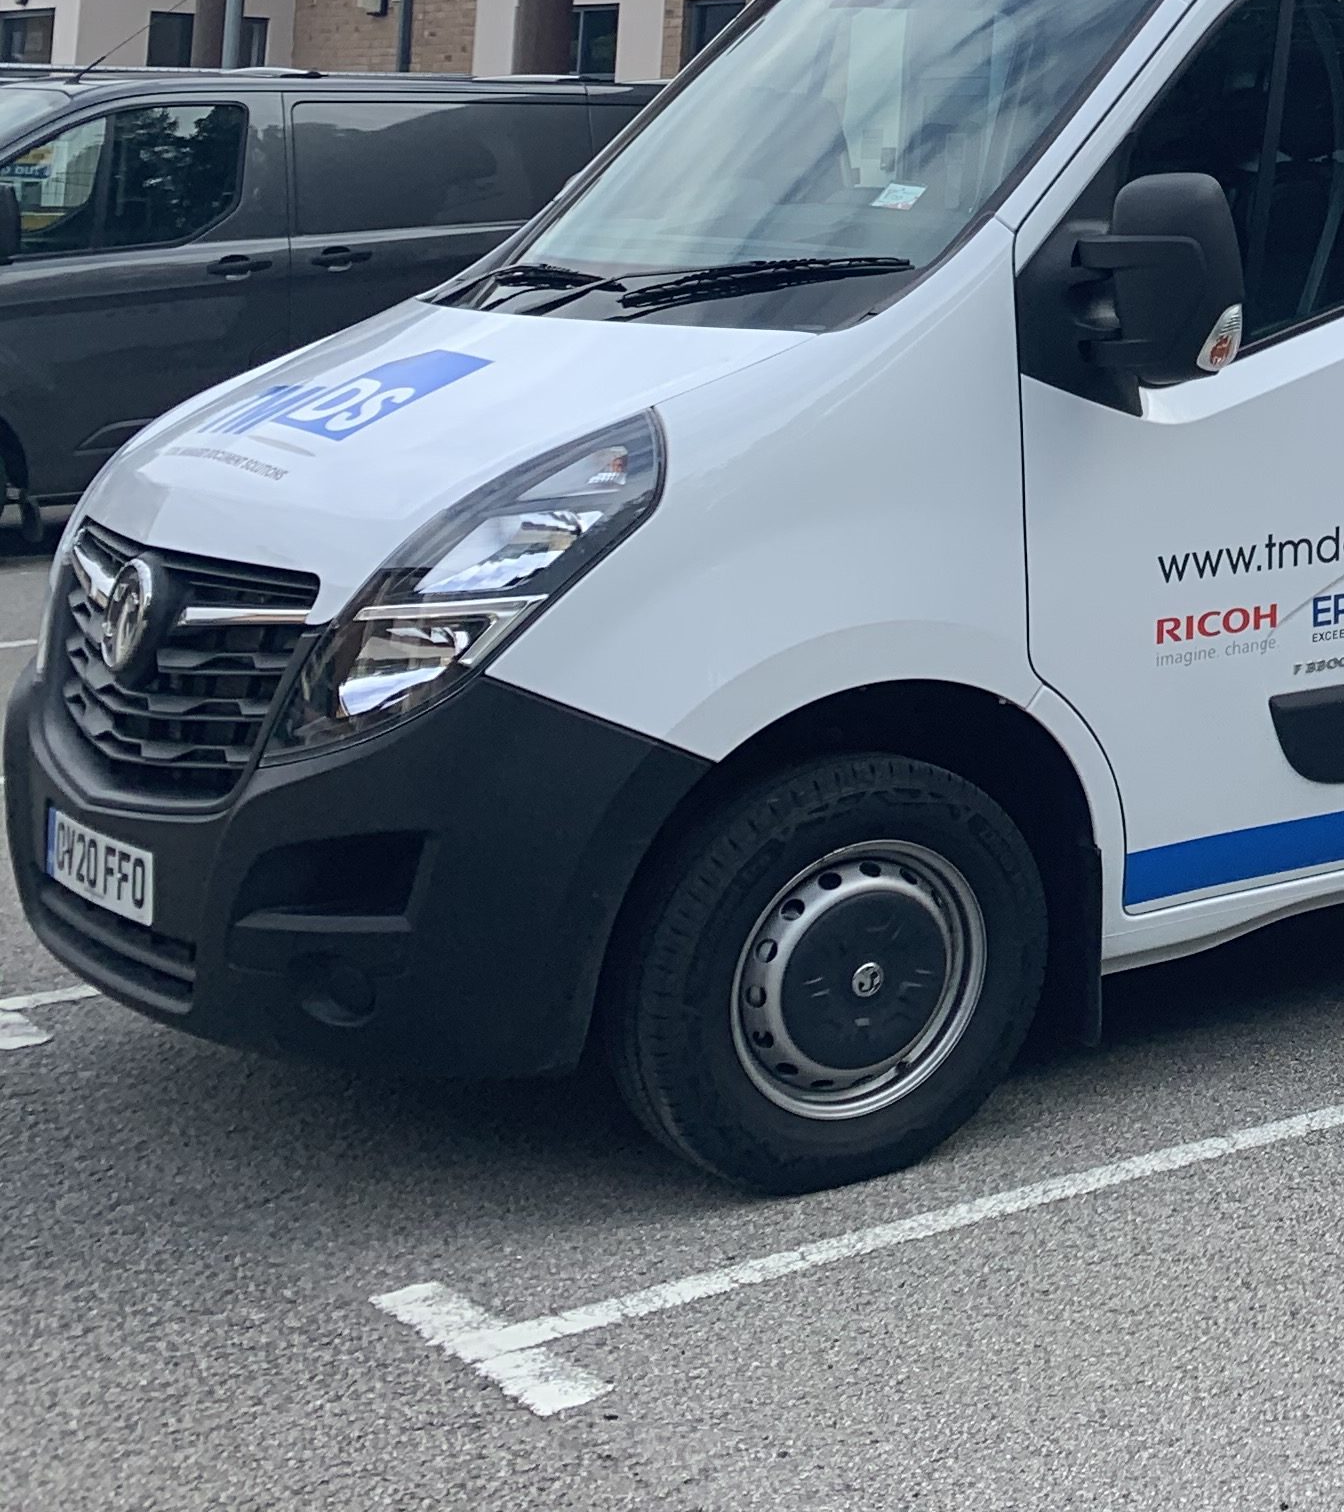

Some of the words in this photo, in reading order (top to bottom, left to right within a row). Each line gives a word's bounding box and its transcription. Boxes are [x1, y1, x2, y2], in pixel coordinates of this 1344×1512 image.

[196, 378, 416, 435] TMDS
[1156, 603, 1278, 645] RICOH
[1155, 647, 1219, 669] imagine.
